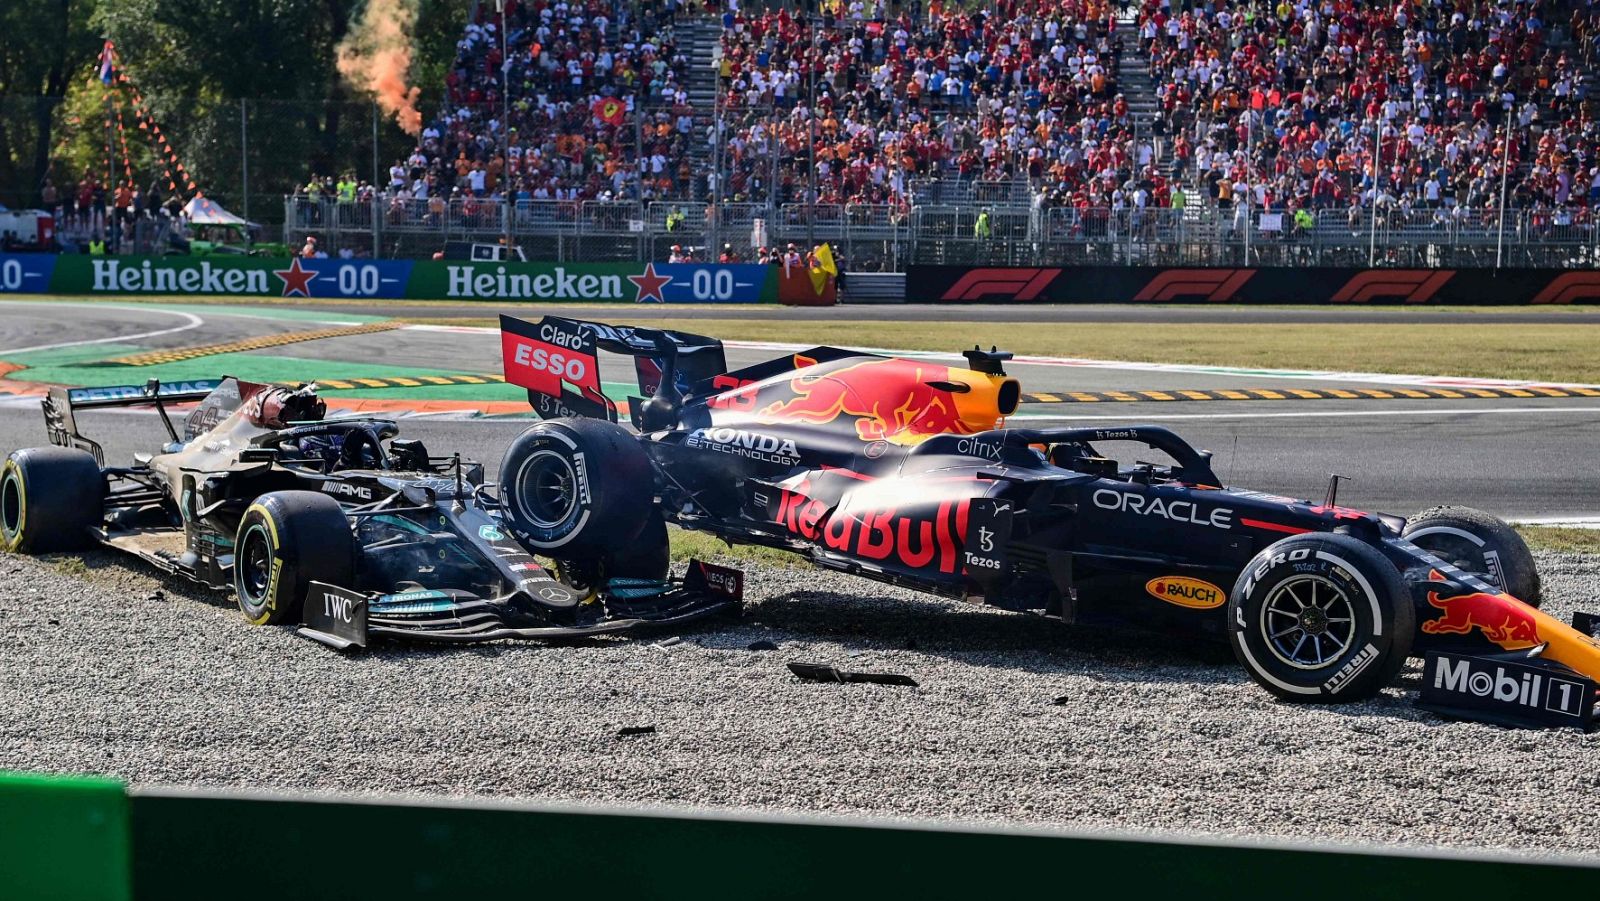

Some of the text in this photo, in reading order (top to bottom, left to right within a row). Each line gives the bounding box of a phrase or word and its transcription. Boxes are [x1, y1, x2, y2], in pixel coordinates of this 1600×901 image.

[0, 259, 22, 290] .0
[92, 259, 269, 293] Heineken
[338, 264, 379, 295] 0.0
[447, 265, 623, 298] Heineken
[693, 269, 733, 300] 0.0
[540, 323, 584, 350] Claro
[514, 343, 585, 381] ESSO
[71, 381, 209, 402] PETRNAS
[688, 428, 801, 459] HONDA
[957, 437, 1003, 460] citrix
[1105, 430, 1129, 439] Tezos
[338, 483, 372, 500] AMG
[573, 452, 592, 505] PIRELLI
[1092, 488, 1234, 529] ORACLE
[964, 551, 1001, 570] Tezos
[1242, 548, 1311, 600] ZERO
[323, 592, 352, 624] IWC
[1167, 583, 1217, 603] RAUCH
[1324, 642, 1381, 695] PIRELLI
[1434, 656, 1542, 708] Mobil
